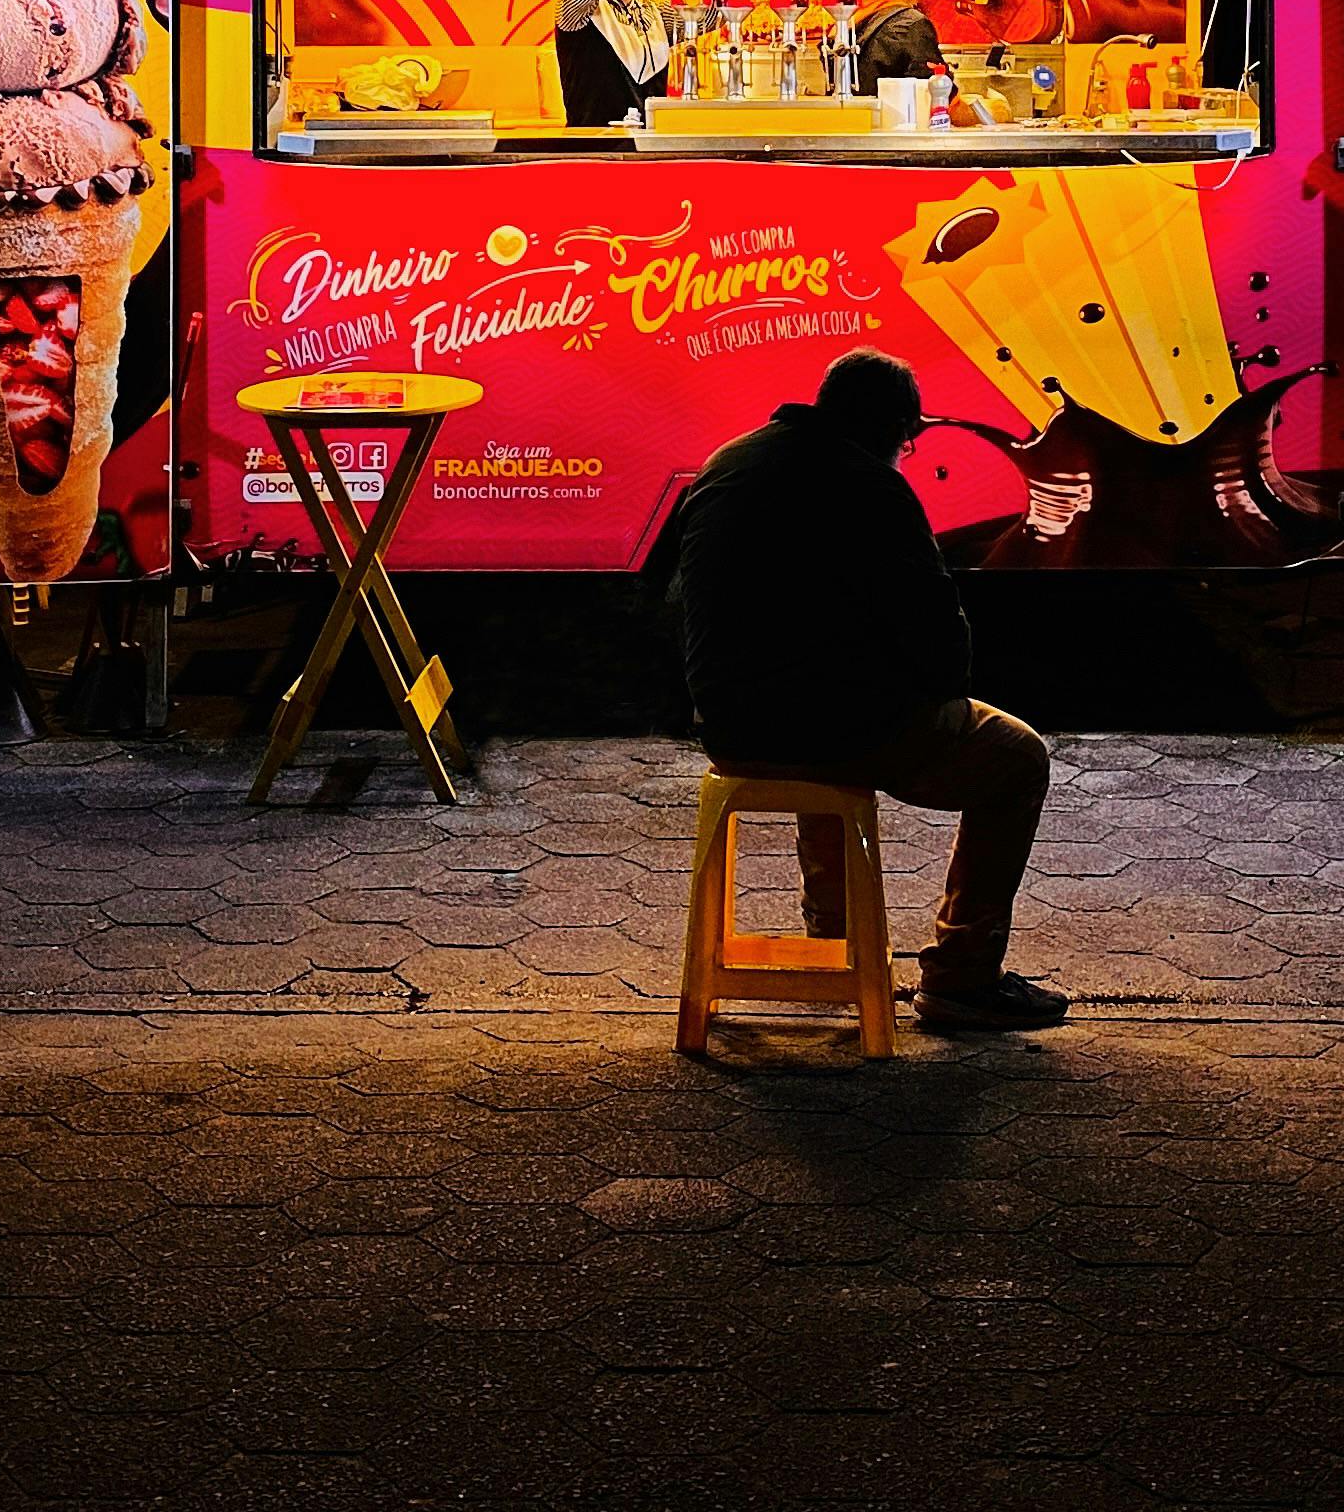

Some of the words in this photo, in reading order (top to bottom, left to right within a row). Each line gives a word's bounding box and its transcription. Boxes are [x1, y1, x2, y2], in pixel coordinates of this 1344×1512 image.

[709, 235, 740, 260] MAS
[741, 225, 796, 255] COMPRA
[281, 247, 459, 323] Dinheiro
[607, 252, 831, 334] Churros
[284, 327, 325, 370] NÃO
[325, 309, 398, 358] COMPRA
[409, 281, 596, 372] Felicidade
[687, 331, 713, 361] QUE
[712, 322, 721, 353] É
[722, 319, 763, 352] QUASE
[765, 320, 775, 341] A
[775, 313, 820, 340] MESMA
[821, 310, 862, 336] COISA
[433, 458, 604, 478] FRANQUEADO
[484, 440, 521, 467] Seja
[524, 445, 553, 458] um
[433, 482, 604, 500] bonochurros.com.br
